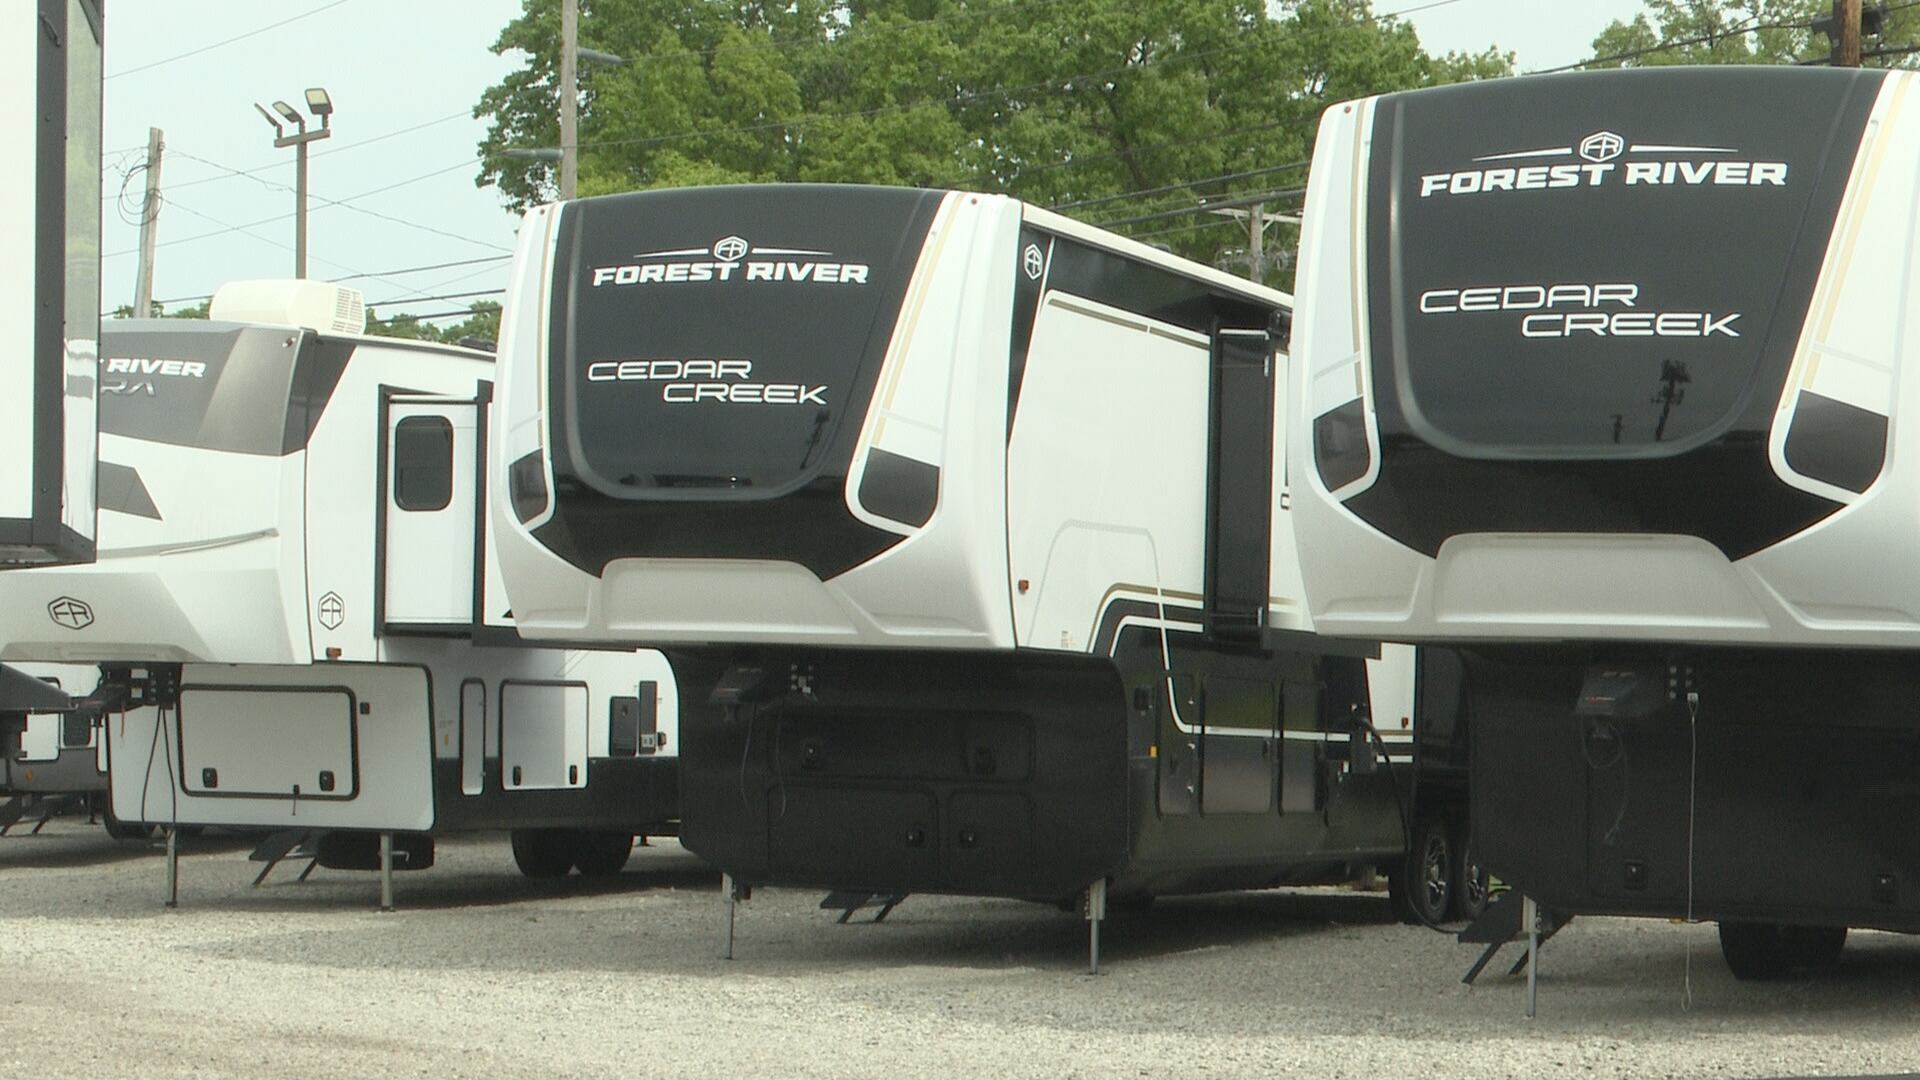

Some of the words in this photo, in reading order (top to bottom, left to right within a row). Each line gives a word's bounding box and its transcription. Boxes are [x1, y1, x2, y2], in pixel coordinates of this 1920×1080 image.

[1420, 164, 1615, 197] FOREST
[1625, 161, 1788, 186] RIVER
[593, 262, 740, 287] FOREST
[746, 262, 869, 284] RIVER
[1420, 284, 1638, 313] CEDAR
[1521, 313, 1741, 337] CREEK
[107, 358, 206, 377] RIVER
[588, 360, 752, 381] CEDAR
[663, 383, 828, 405] CREEK
